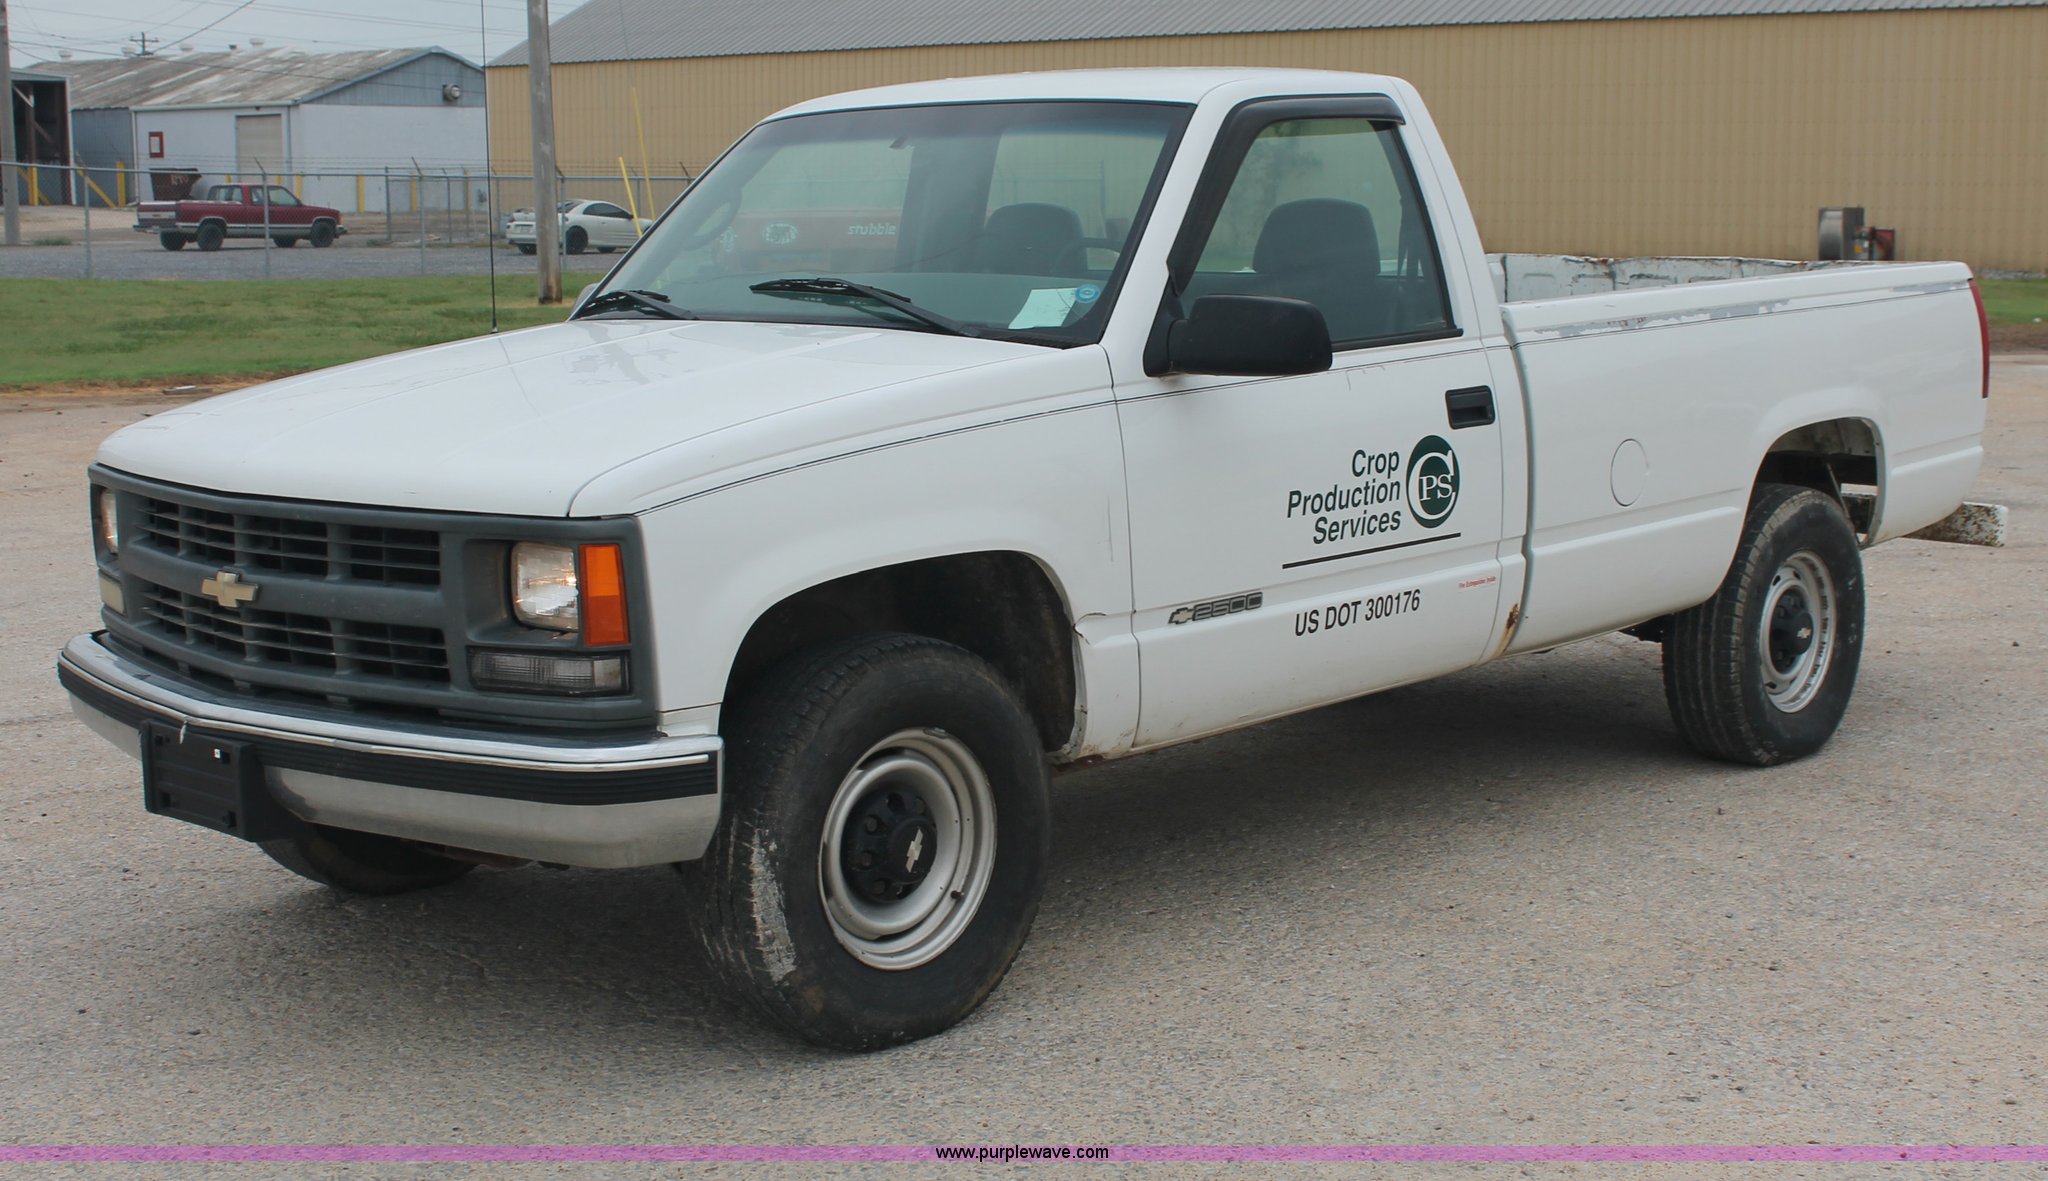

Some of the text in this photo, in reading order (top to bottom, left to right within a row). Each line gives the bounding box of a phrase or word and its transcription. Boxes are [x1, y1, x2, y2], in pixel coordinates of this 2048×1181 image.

[1351, 449, 1400, 479] Crop
[1287, 478, 1401, 518] Production
[1313, 510, 1401, 544] Services
[1192, 592, 1263, 621] 2500
[1295, 589, 1420, 636] US DOT 300176
